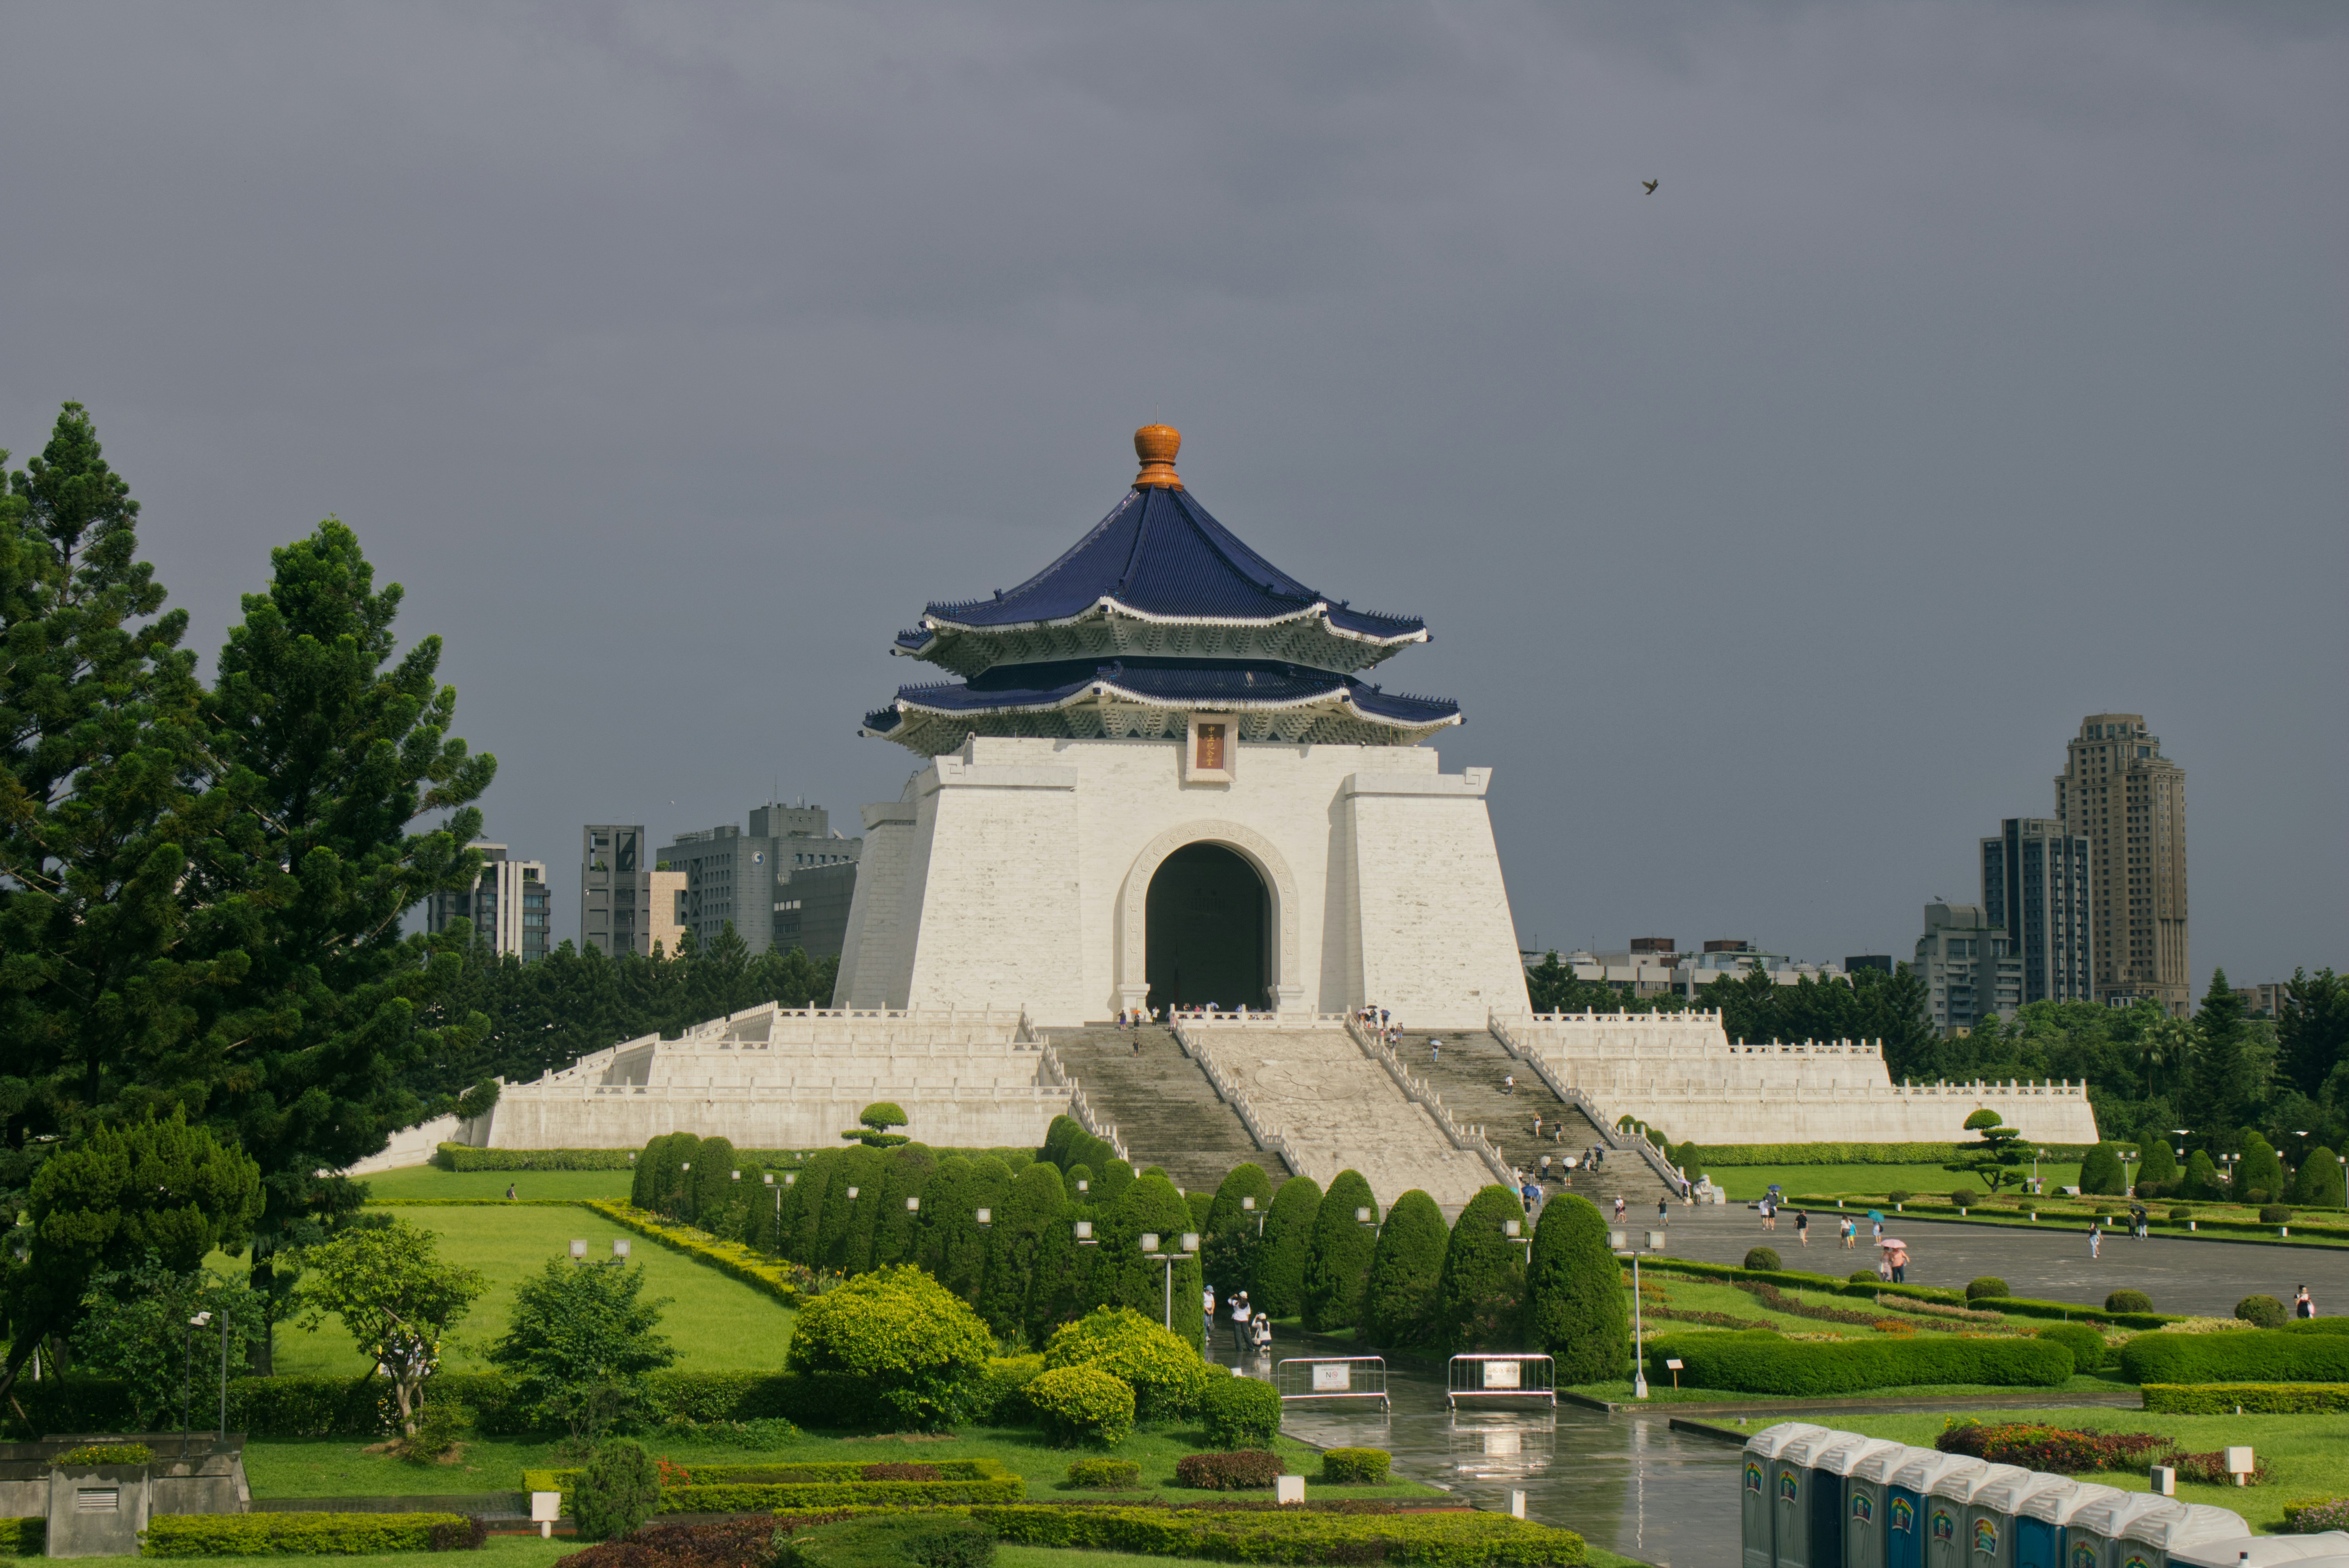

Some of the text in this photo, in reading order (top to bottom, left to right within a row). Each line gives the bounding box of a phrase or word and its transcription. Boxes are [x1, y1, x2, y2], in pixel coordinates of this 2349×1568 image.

[1206, 726, 1215, 766] 中正紀念堂
